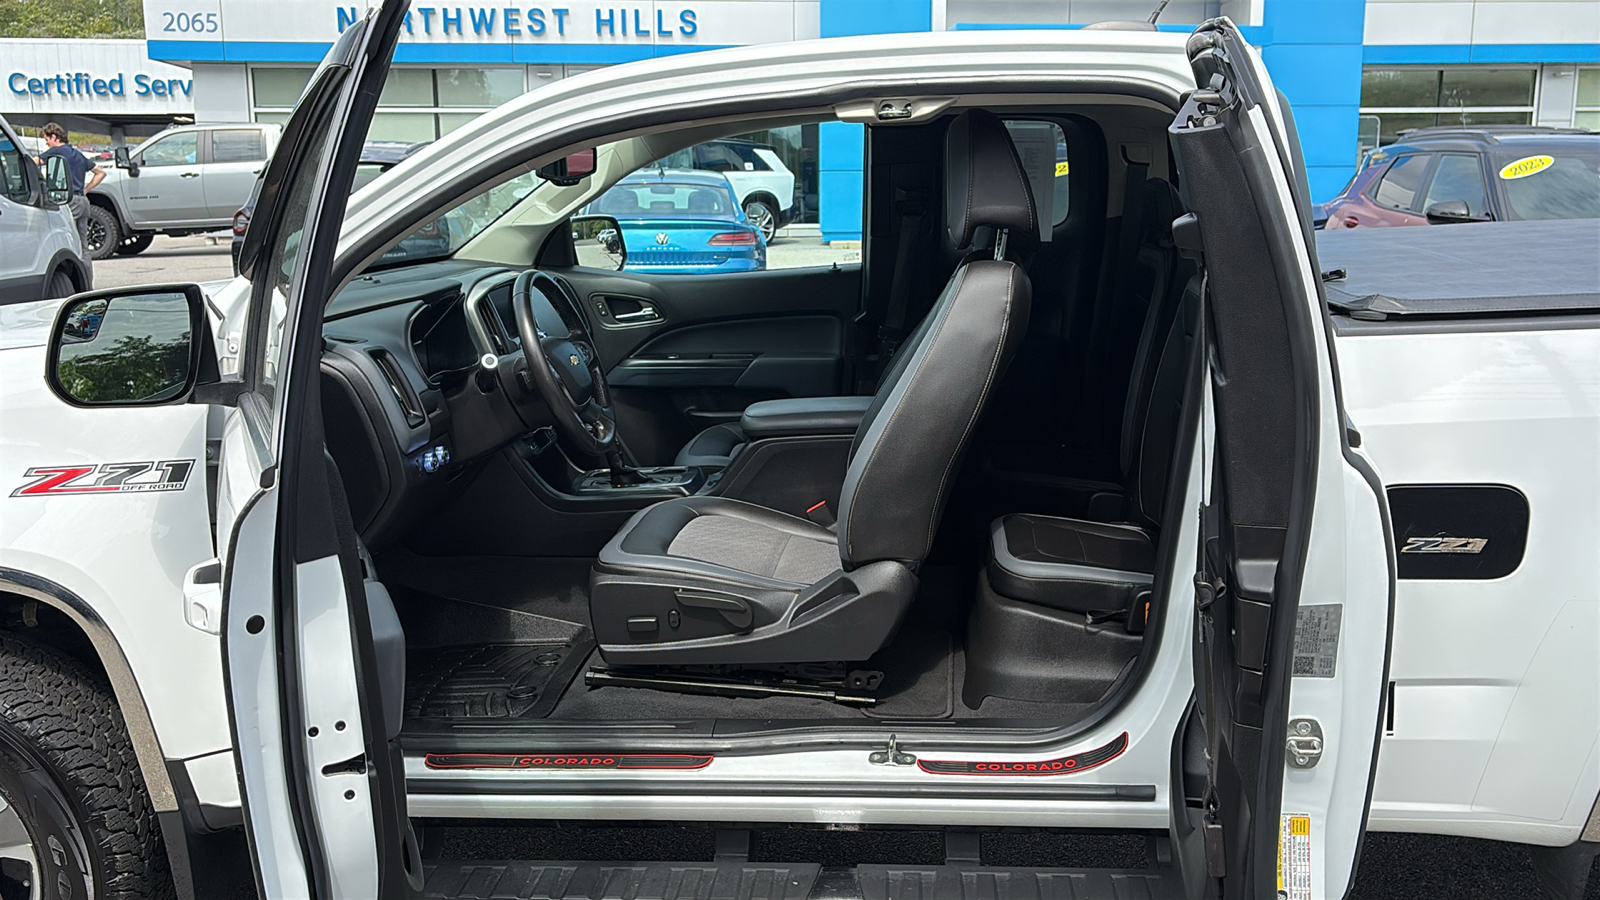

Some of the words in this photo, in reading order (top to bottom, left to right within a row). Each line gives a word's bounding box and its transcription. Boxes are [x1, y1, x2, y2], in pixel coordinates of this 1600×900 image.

[162, 12, 218, 33] 2065
[336, 7, 570, 36] NRTHWEST
[595, 9, 698, 36] HILLS
[8, 72, 125, 96] Certified
[134, 73, 193, 96] Serv
[1510, 158, 1545, 177] 2023
[9, 458, 196, 498] Z71
[148, 482, 184, 490] ROAD
[519, 757, 615, 766] COLORADO
[975, 758, 1077, 772] COLORADO
